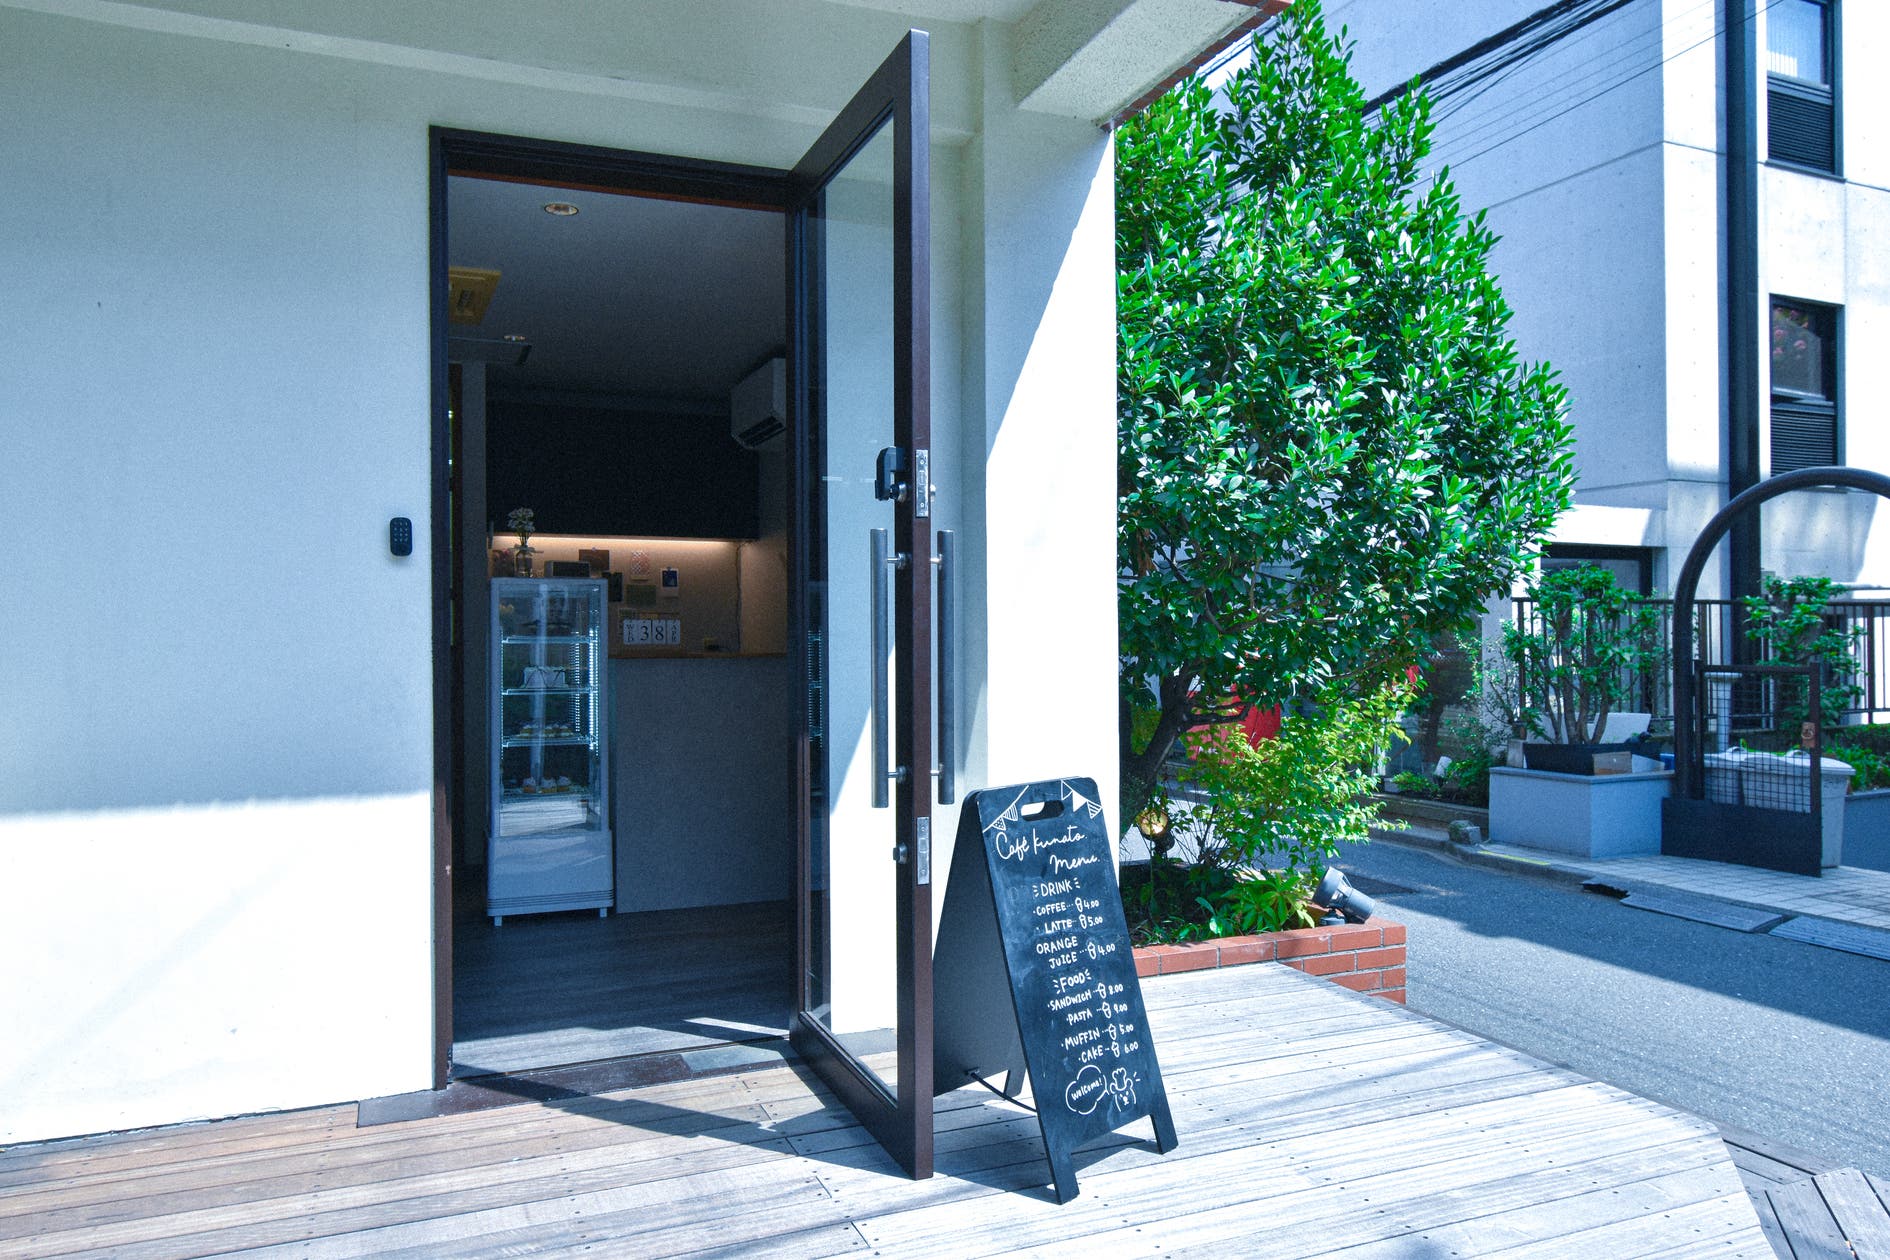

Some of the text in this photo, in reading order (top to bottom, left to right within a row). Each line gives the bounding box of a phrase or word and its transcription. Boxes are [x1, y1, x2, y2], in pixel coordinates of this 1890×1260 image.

[996, 831, 1030, 862] Café
[1040, 879, 1073, 898] DRINK
[1044, 918, 1073, 934] LATTE
[1036, 936, 1078, 955] ORANGE
[1048, 952, 1078, 969] JUICE
[1060, 972, 1086, 993] FOOD
[1050, 990, 1092, 1011] SANDWICH
[1068, 1008, 1093, 1026] PASTA
[1065, 1027, 1101, 1051] MUFFIN
[1081, 1044, 1104, 1063] CAKE
